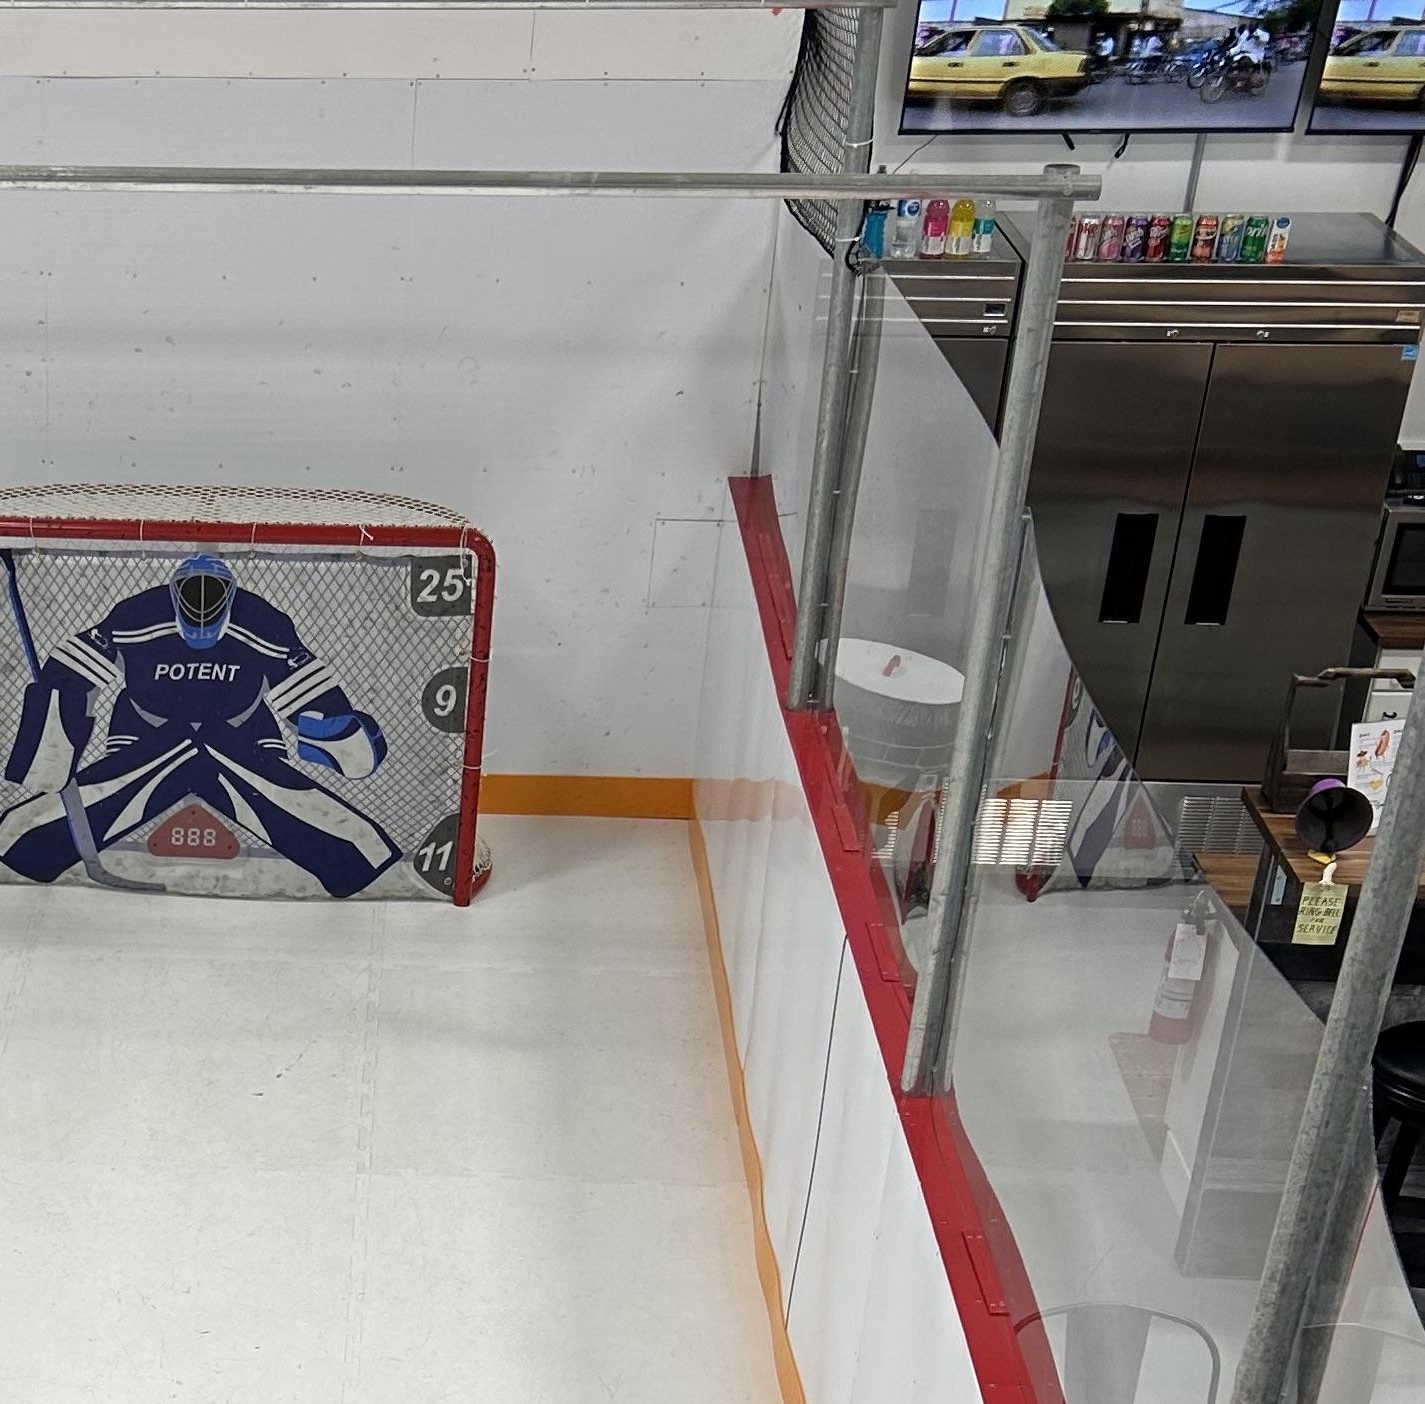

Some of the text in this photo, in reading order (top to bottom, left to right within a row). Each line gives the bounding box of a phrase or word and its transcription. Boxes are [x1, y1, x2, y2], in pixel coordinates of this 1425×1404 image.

[417, 568, 464, 603] 25
[154, 662, 241, 682] POTENT
[434, 684, 457, 717] 9
[171, 827, 216, 846] 888
[418, 840, 454, 872] 11
[1301, 896, 1342, 907] PLEASE
[1297, 924, 1338, 934] SERVICE
